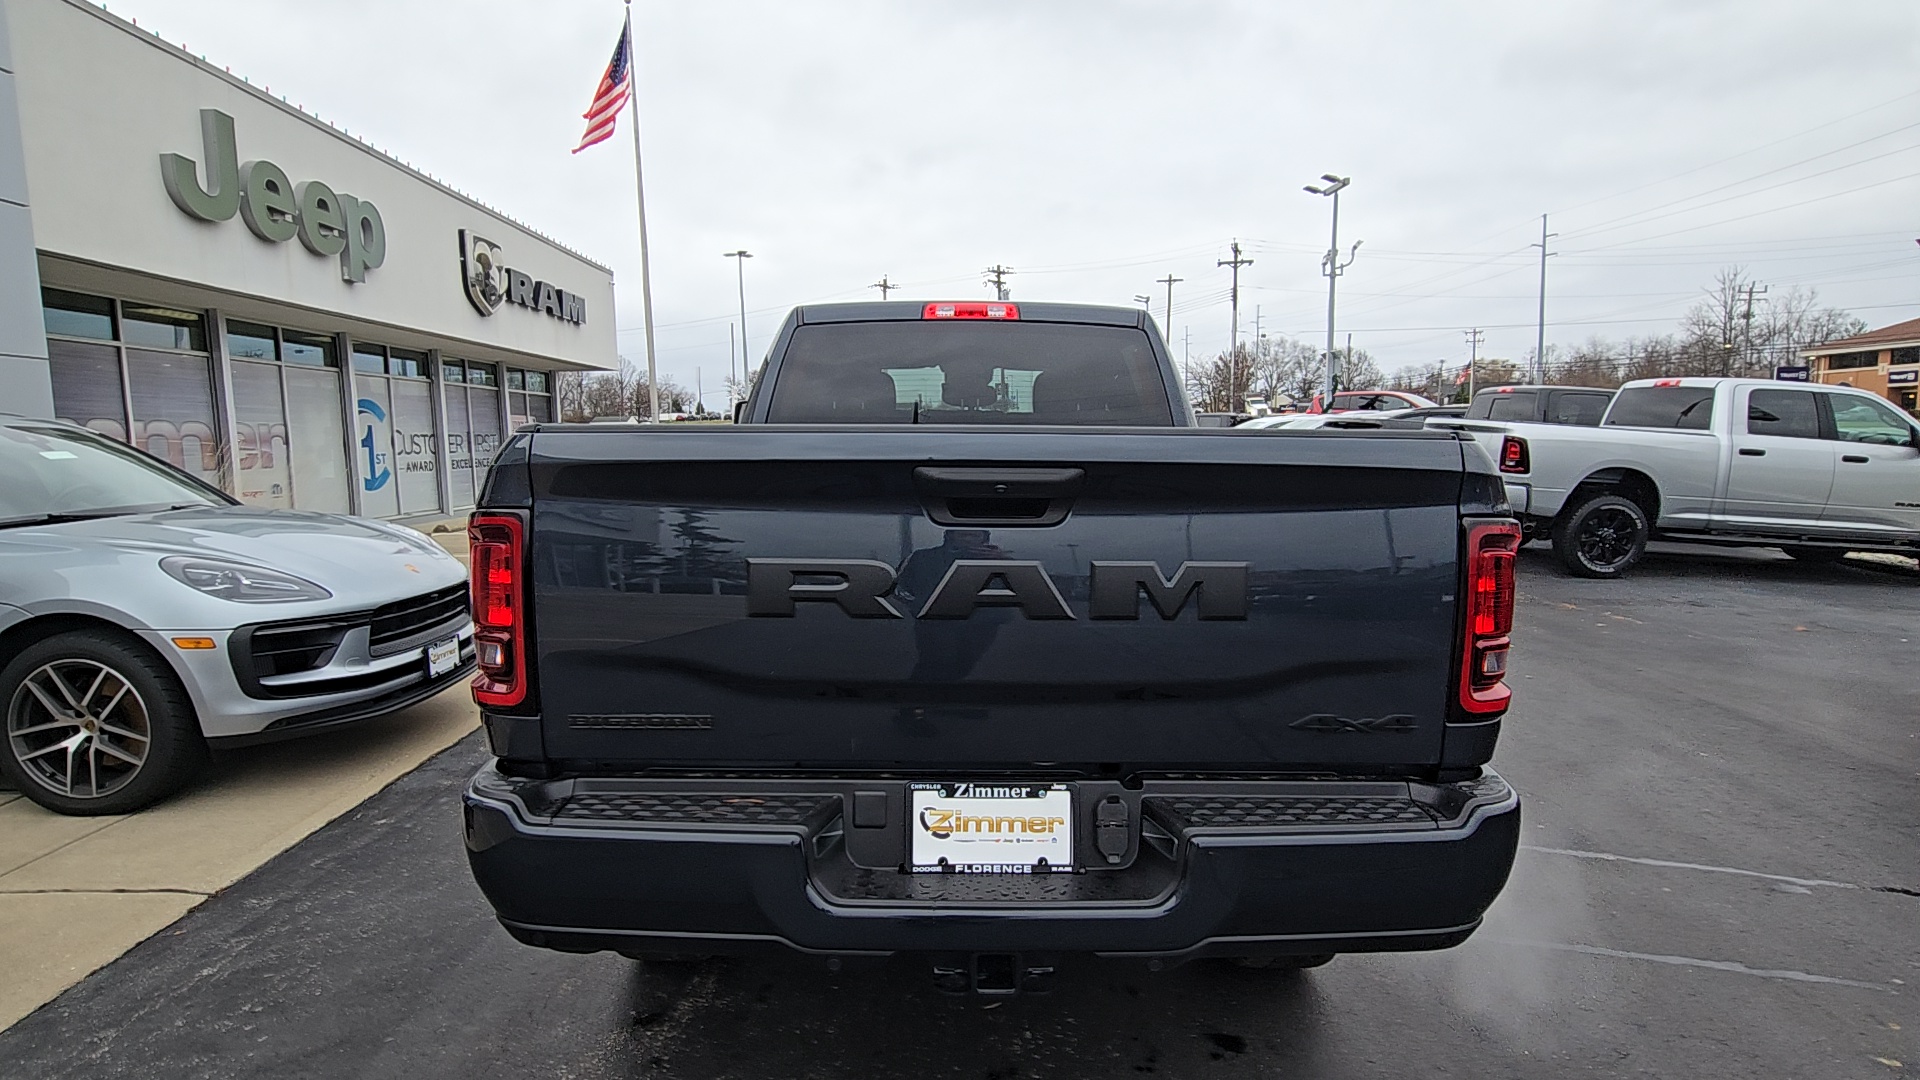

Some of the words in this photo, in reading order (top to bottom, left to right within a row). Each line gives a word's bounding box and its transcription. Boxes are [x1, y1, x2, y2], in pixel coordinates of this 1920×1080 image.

[160, 108, 387, 284] Jeep
[504, 267, 587, 325] RAM
[391, 429, 464, 456] CUSTOER
[406, 461, 434, 473] AWARD
[451, 458, 492, 470] EXCELENCE
[746, 558, 1249, 621] RAM
[953, 783, 1031, 798] Zimmer
[928, 809, 1065, 834] Zimmer
[955, 864, 1032, 874] FLORENCE
